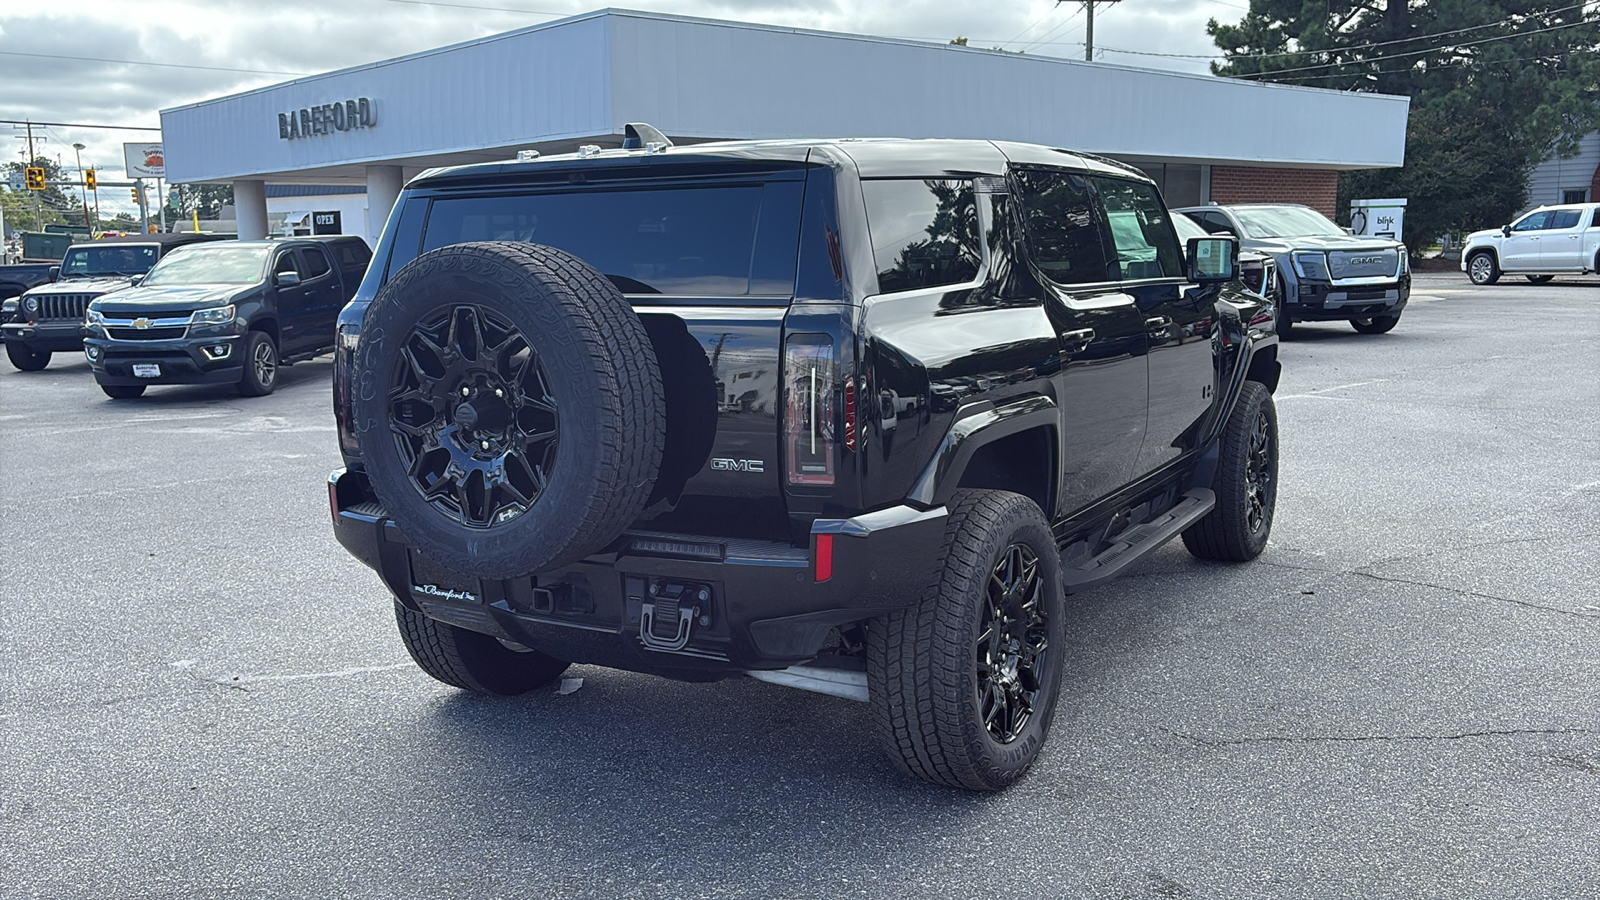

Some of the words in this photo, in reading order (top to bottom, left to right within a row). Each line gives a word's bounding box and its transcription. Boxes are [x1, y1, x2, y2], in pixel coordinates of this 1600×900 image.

[278, 97, 377, 140] BAREFORD
[316, 214, 335, 225] OPEN
[1377, 216, 1394, 224] blink
[1351, 256, 1382, 264] GMC
[710, 457, 764, 473] GMC
[423, 584, 465, 600] Bareford
